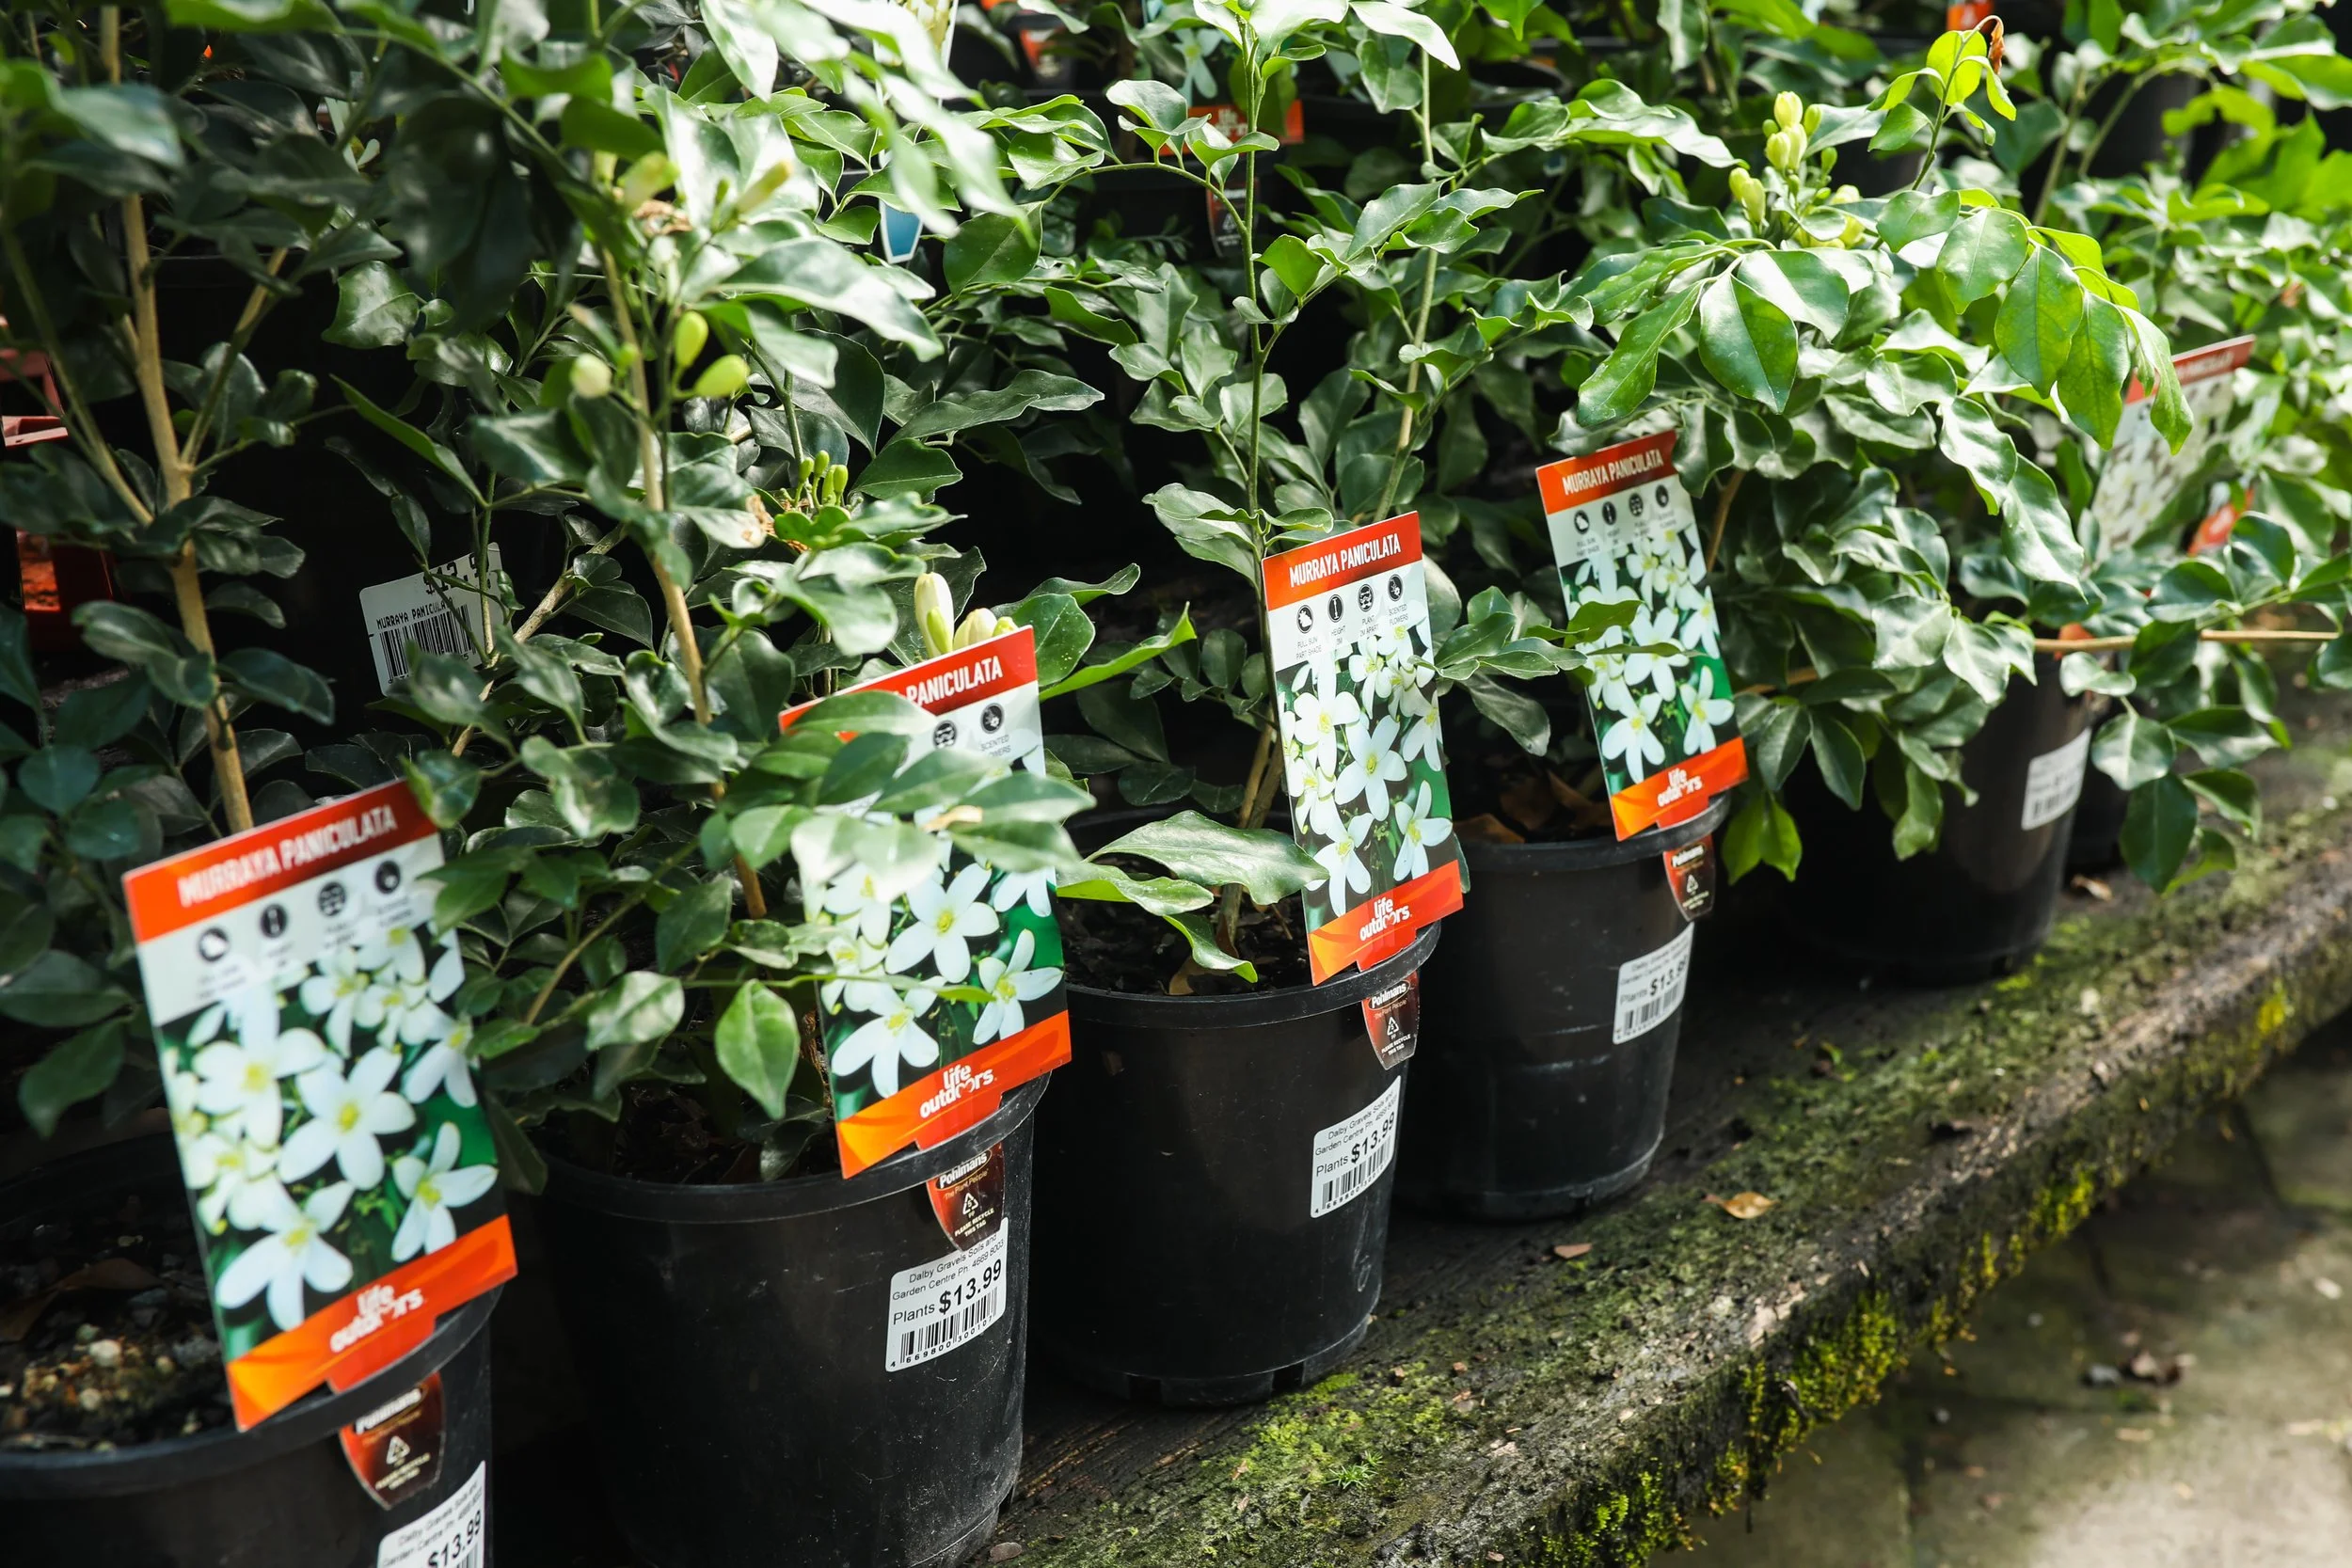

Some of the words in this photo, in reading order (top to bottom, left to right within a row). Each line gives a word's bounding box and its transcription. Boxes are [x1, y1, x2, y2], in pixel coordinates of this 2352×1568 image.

[1562, 465, 1610, 496] MURRAYA
[1608, 449, 1664, 481] PANICULATA
[1289, 553, 1340, 588] MURRAYA
[1341, 533, 1401, 571] PANICULATA
[376, 612, 409, 629] MURRAYA
[906, 656, 1003, 706] PANICULATA
[177, 849, 281, 908] MURRAYA
[279, 804, 398, 872] PANICULATA
[1359, 904, 1410, 942] outdoors
[1374, 896, 1394, 919] life
[1372, 983, 1406, 1008] Pohlmans
[920, 1069, 995, 1117] outdoors
[943, 1064, 972, 1089] life
[1315, 1140, 1342, 1155] Garden
[1316, 1155, 1348, 1177] Plants
[1351, 1112, 1395, 1164] $13.99
[1328, 1126, 1349, 1139] Dalby
[939, 1152, 988, 1189] Pohlmans
[955, 1221, 972, 1237] PLEASE
[972, 1208, 994, 1225] RECYCLE
[964, 1227, 977, 1237] THIS
[976, 1220, 987, 1229] TAG
[893, 1285, 926, 1301] Garden
[929, 1272, 956, 1290] Centre
[972, 1254, 989, 1267] 4669
[909, 1269, 934, 1283] Dalby
[936, 1254, 967, 1273] Gravels
[968, 1243, 984, 1258] Soils
[985, 1234, 997, 1247] and
[893, 1303, 935, 1325] Plants
[939, 1259, 1002, 1315] $13.99
[428, 1509, 481, 1568] $13.99
